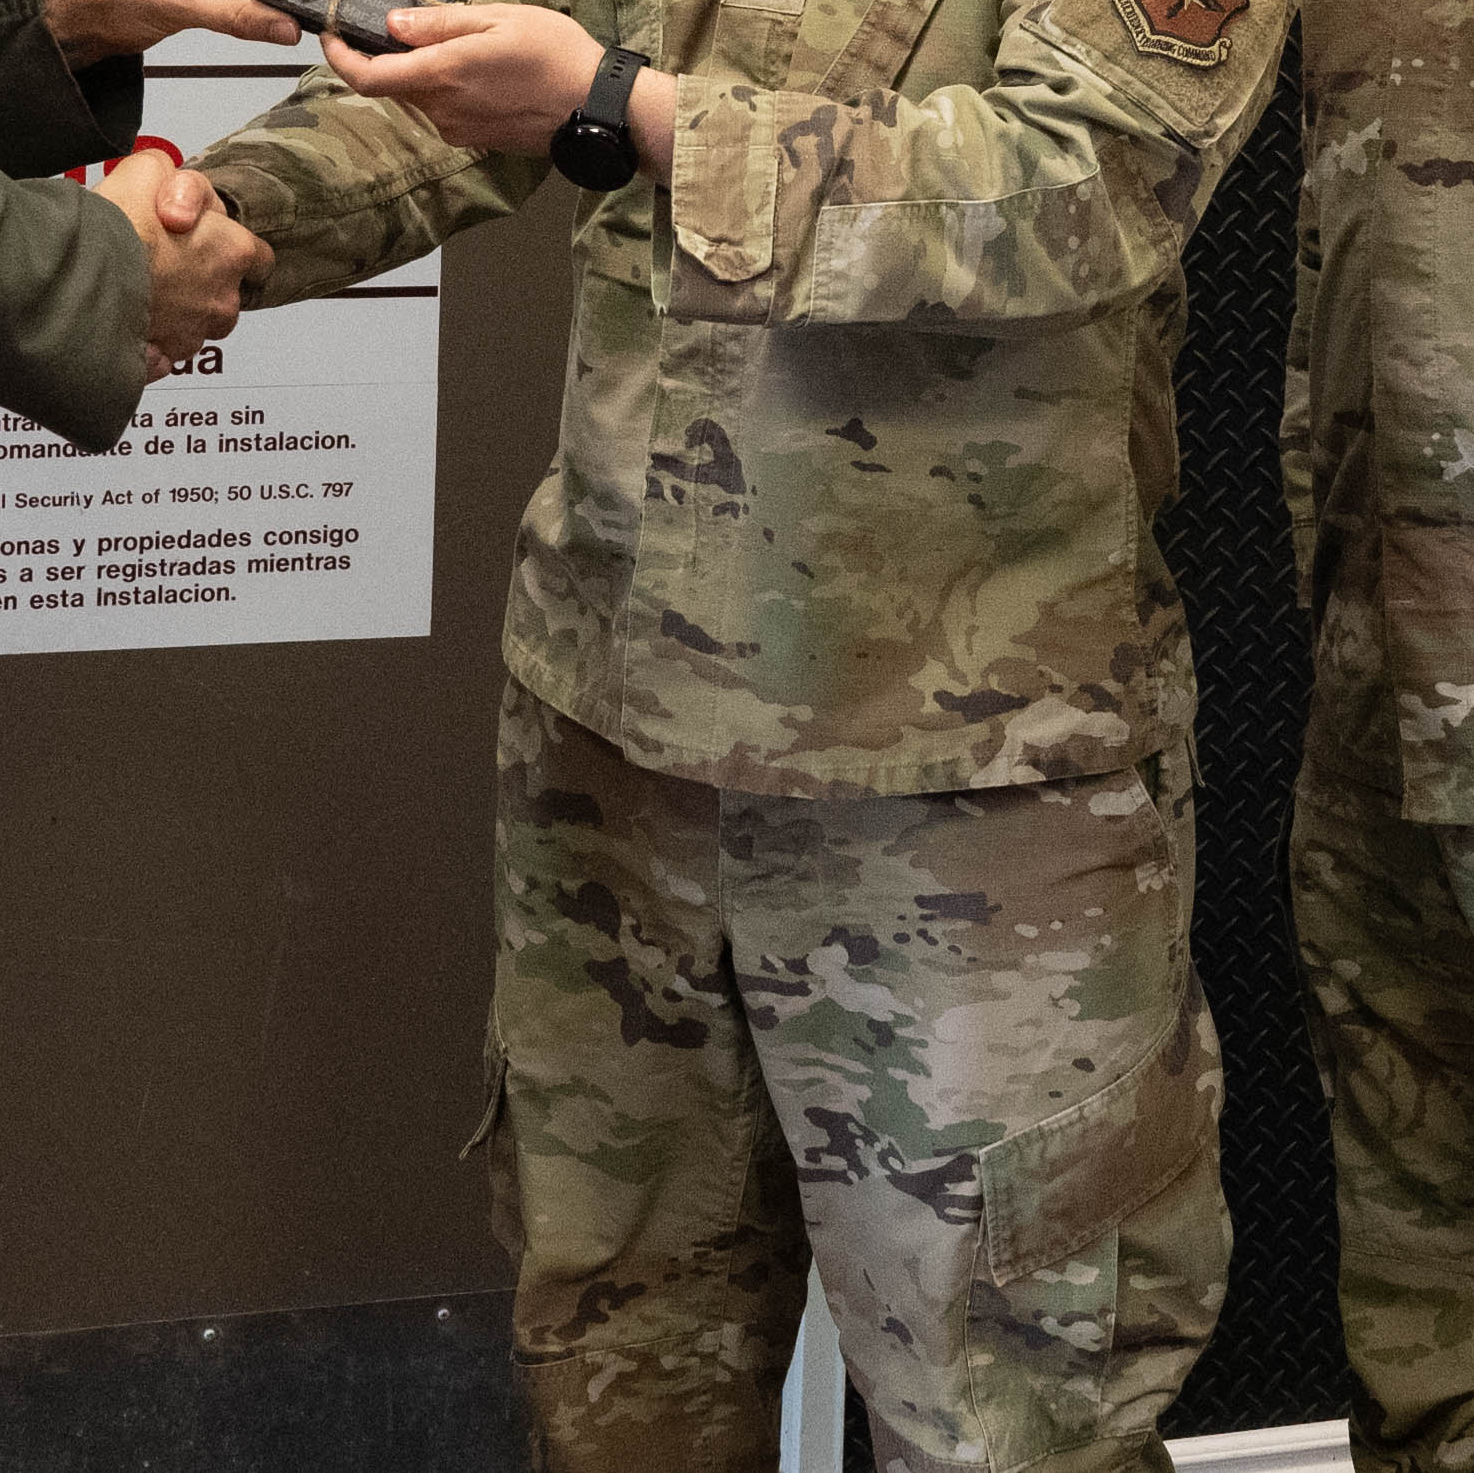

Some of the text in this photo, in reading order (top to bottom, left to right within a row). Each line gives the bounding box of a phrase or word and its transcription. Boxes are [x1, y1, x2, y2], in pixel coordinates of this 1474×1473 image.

[164, 406, 219, 428] área
[230, 404, 265, 426] sin
[143, 434, 175, 456] de
[186, 434, 207, 454] la
[218, 430, 356, 454] instalacion.
[101, 489, 134, 506] Act
[141, 488, 161, 505] of
[168, 486, 219, 505] 1950;
[226, 484, 252, 502] 50
[259, 483, 314, 501] U.S.C.
[321, 481, 354, 498] 797
[72, 538, 86, 558] y
[97, 527, 252, 554] propiedades
[263, 524, 360, 549] consigo
[19, 567, 34, 583] a
[45, 564, 87, 582] ser
[96, 555, 236, 584] registradas
[247, 552, 351, 574] mientras
[29, 588, 85, 610] esta
[96, 582, 237, 607] Instalacion.
